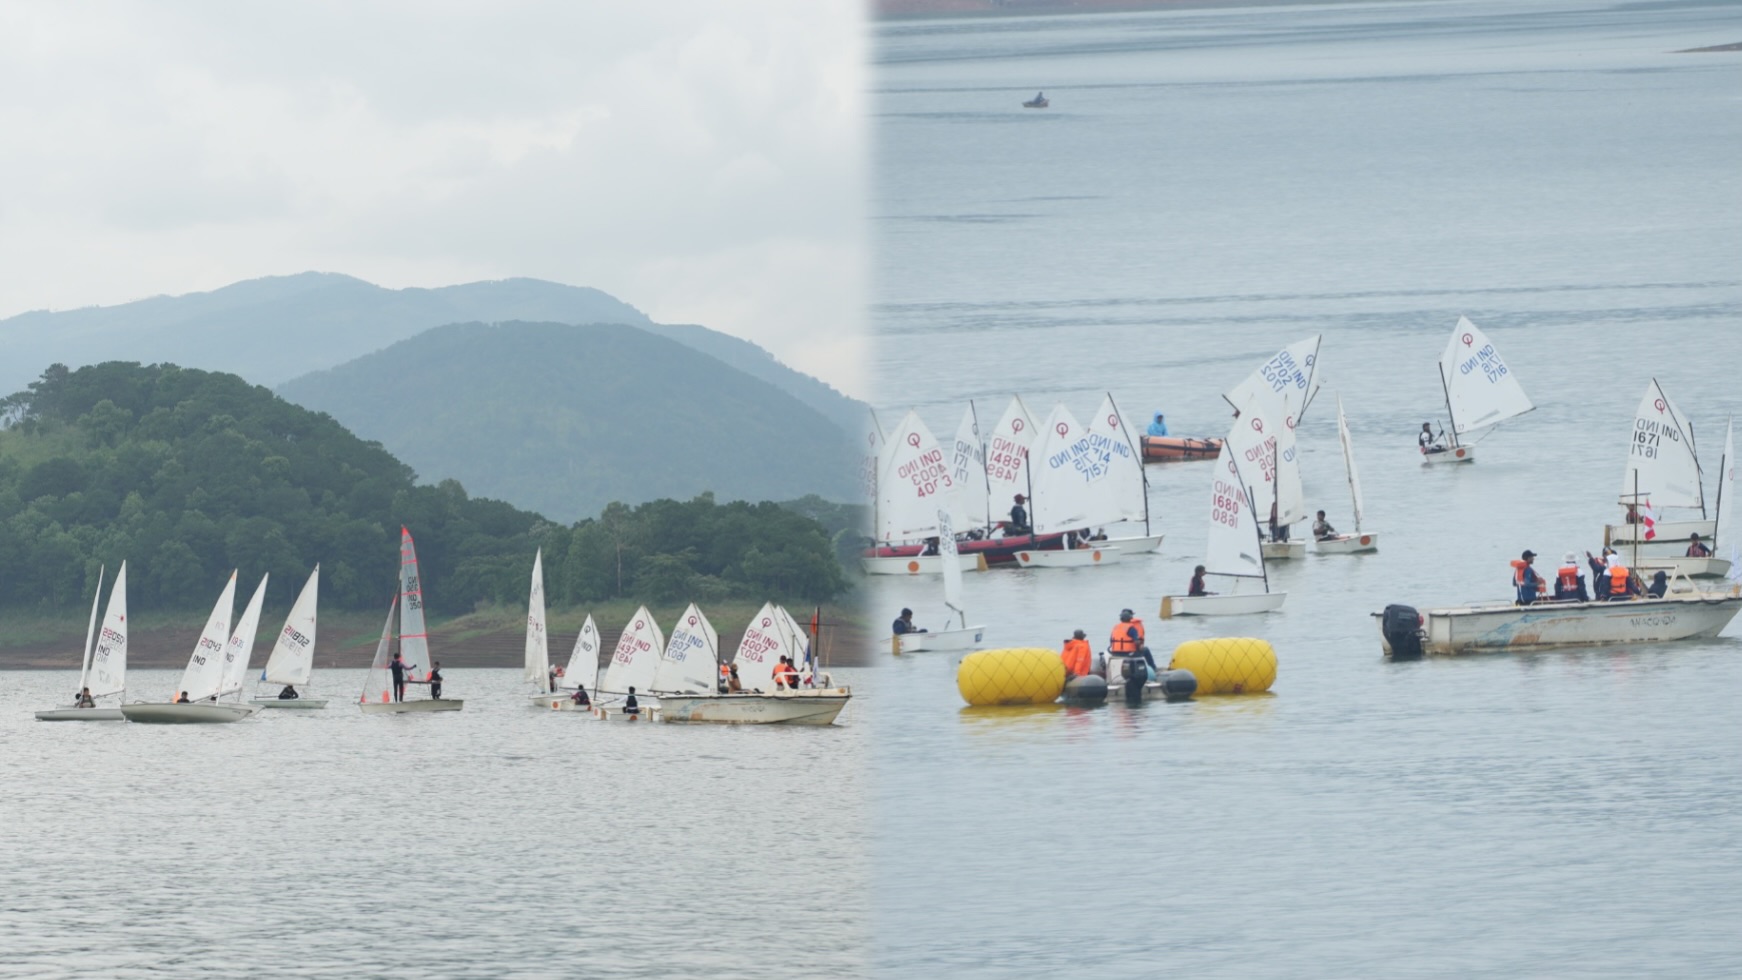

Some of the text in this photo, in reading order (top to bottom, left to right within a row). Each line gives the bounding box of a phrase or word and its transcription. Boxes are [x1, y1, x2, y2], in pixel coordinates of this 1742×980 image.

[1476, 344, 1494, 362] IND
[1270, 357, 1293, 386] 1702
[1292, 369, 1306, 389] IND
[1487, 364, 1507, 384] 1716
[1633, 430, 1660, 447] 1671
[1661, 423, 1679, 442] IND
[1070, 438, 1090, 457] IND
[1113, 440, 1130, 458] IND
[919, 449, 943, 468] IND
[989, 451, 1021, 470] 1489
[1213, 493, 1239, 515] 1680
[635, 639, 651, 652] IND
[670, 639, 690, 652] 1607
[687, 635, 704, 649] IND
[743, 639, 769, 654] 4007
[763, 636, 779, 650] IND
[192, 655, 206, 666] IND
